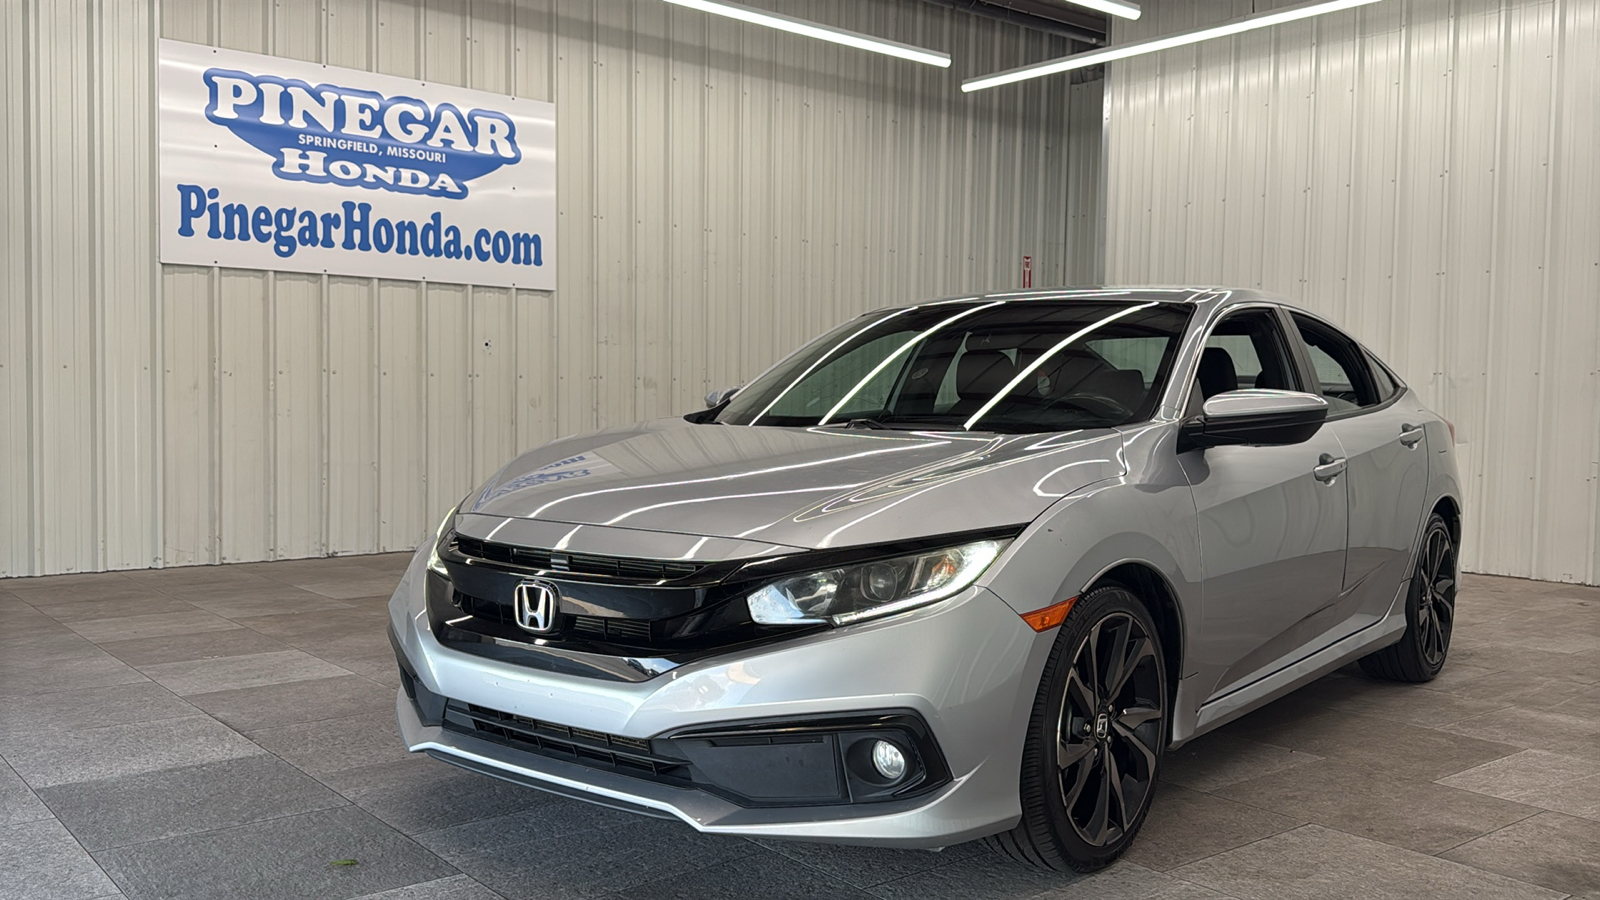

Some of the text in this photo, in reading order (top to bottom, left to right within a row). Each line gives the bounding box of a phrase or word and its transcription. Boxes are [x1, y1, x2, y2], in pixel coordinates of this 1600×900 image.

[211, 75, 516, 158] PINEGAR
[297, 134, 446, 163] SPRINGFIELD, MISSOURI
[279, 147, 463, 193] HONDA
[177, 184, 543, 266] PinegarHonda.com
